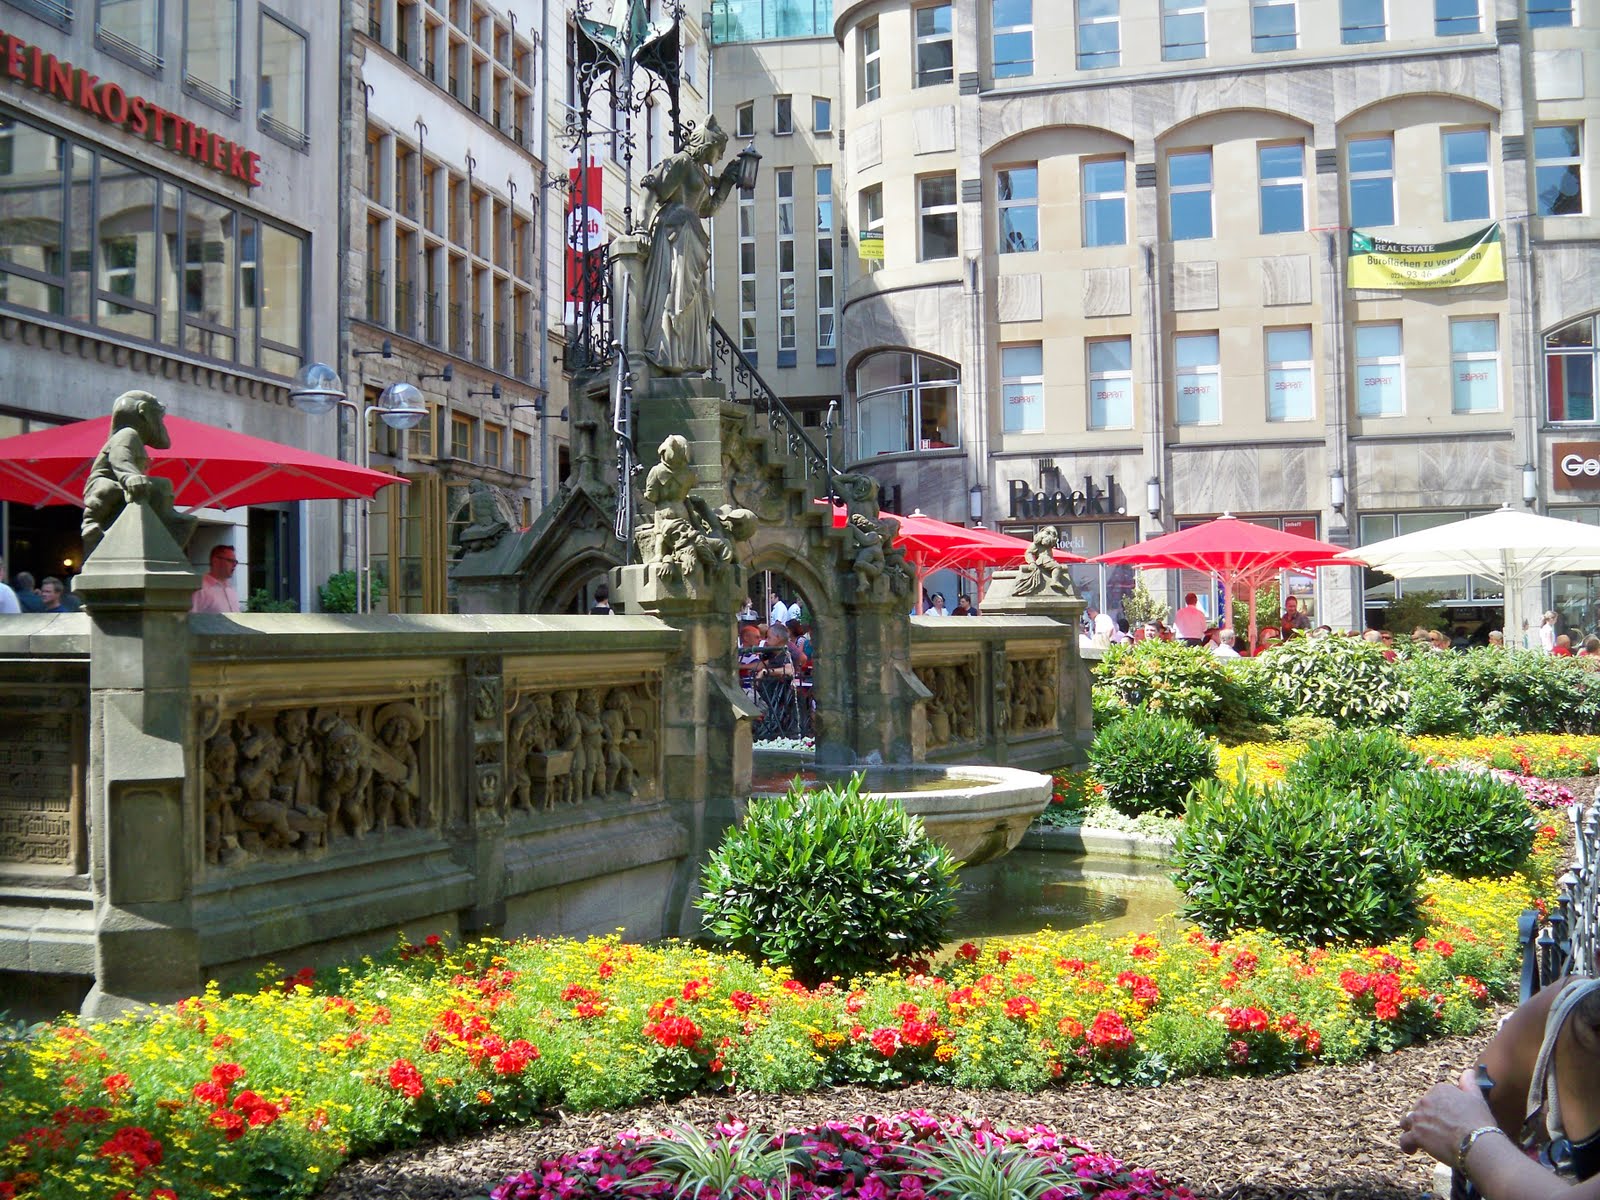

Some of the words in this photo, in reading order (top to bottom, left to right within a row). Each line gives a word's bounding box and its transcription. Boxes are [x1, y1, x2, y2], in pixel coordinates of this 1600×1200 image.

[0, 29, 262, 187] EINKOSTTHEKE
[1375, 244, 1399, 253] REAL
[1400, 245, 1435, 253] ESTATE
[1367, 255, 1421, 268] Büroflächen
[1424, 260, 1434, 268] zu
[1364, 376, 1392, 386] ESPRIT
[1460, 372, 1489, 382] ESPRIT
[1183, 385, 1211, 395] ESPRIT
[1275, 382, 1303, 391] ESPRIT
[1009, 395, 1036, 405] ESPRIT
[1096, 390, 1125, 400] ESPRIT
[1561, 454, 1600, 477] Ge
